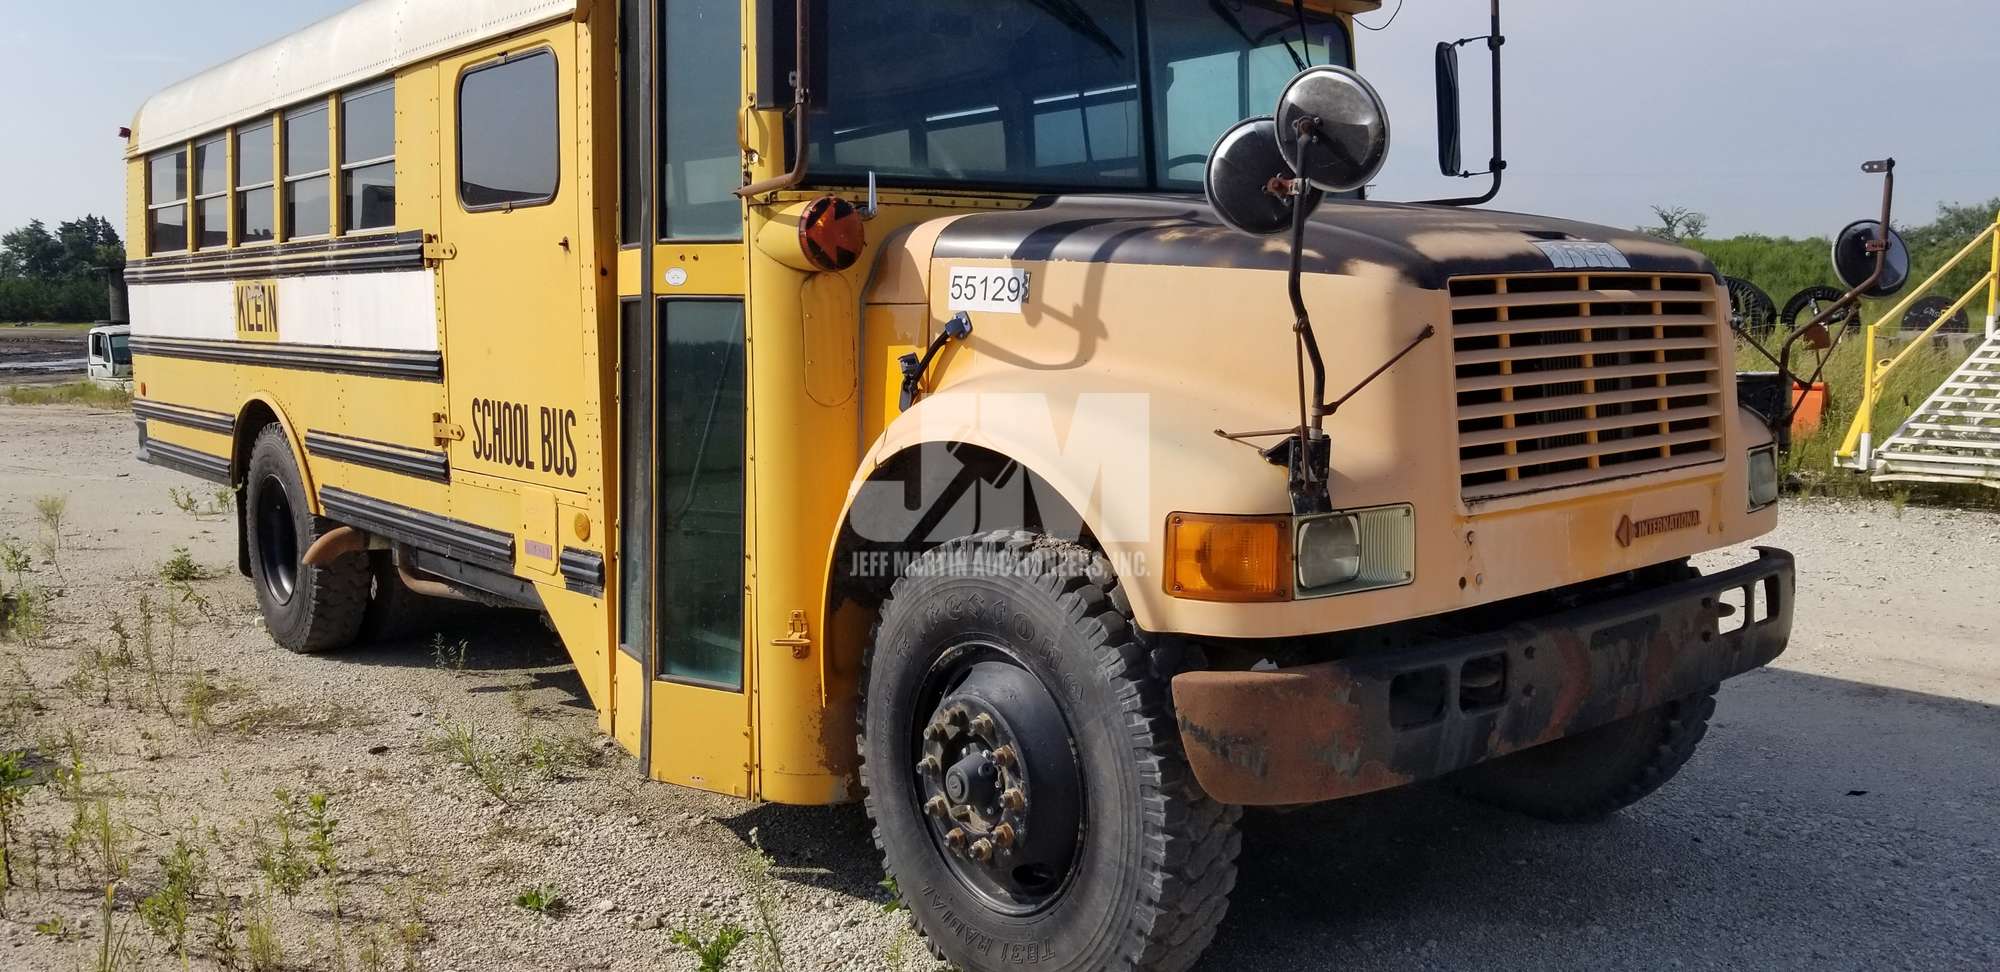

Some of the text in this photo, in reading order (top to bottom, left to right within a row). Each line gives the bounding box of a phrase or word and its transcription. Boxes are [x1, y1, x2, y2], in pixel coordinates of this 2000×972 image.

[236, 285, 278, 332] KLEIN
[950, 275, 1021, 302] 55129
[472, 397, 577, 478] SCHOOL BUS
